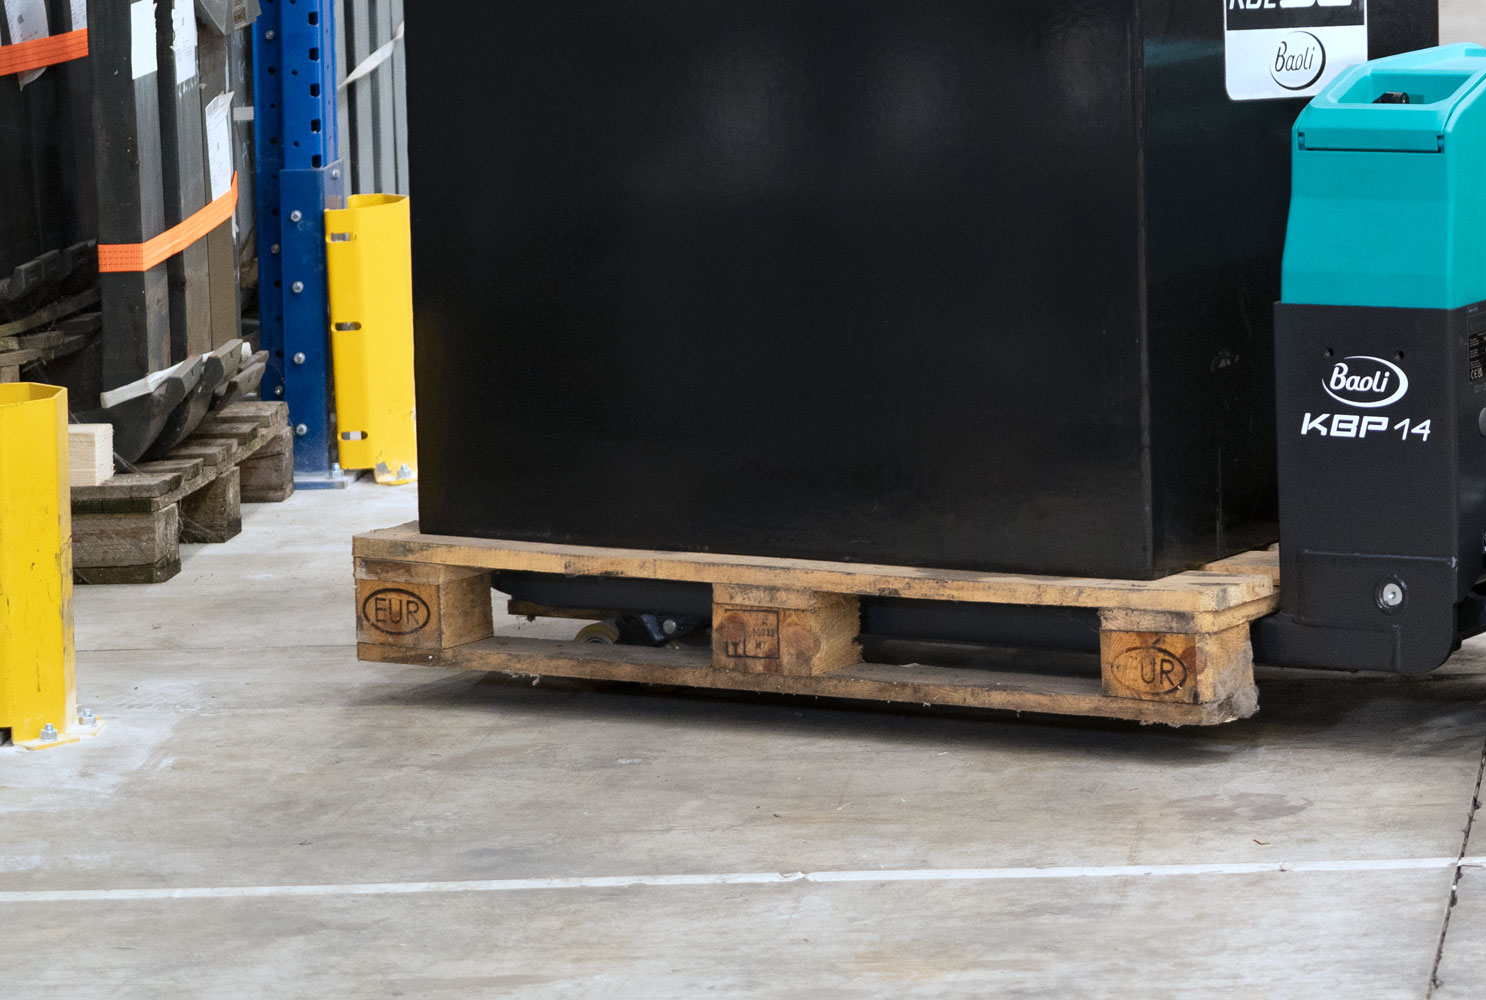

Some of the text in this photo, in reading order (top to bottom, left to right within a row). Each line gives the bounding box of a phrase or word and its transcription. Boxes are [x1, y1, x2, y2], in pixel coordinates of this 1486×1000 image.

[1275, 41, 1315, 72] Baoli
[1329, 362, 1390, 392] Baoli
[1301, 412, 1431, 442] KBP 14
[374, 597, 420, 625] EUR
[1134, 655, 1175, 687] UR
